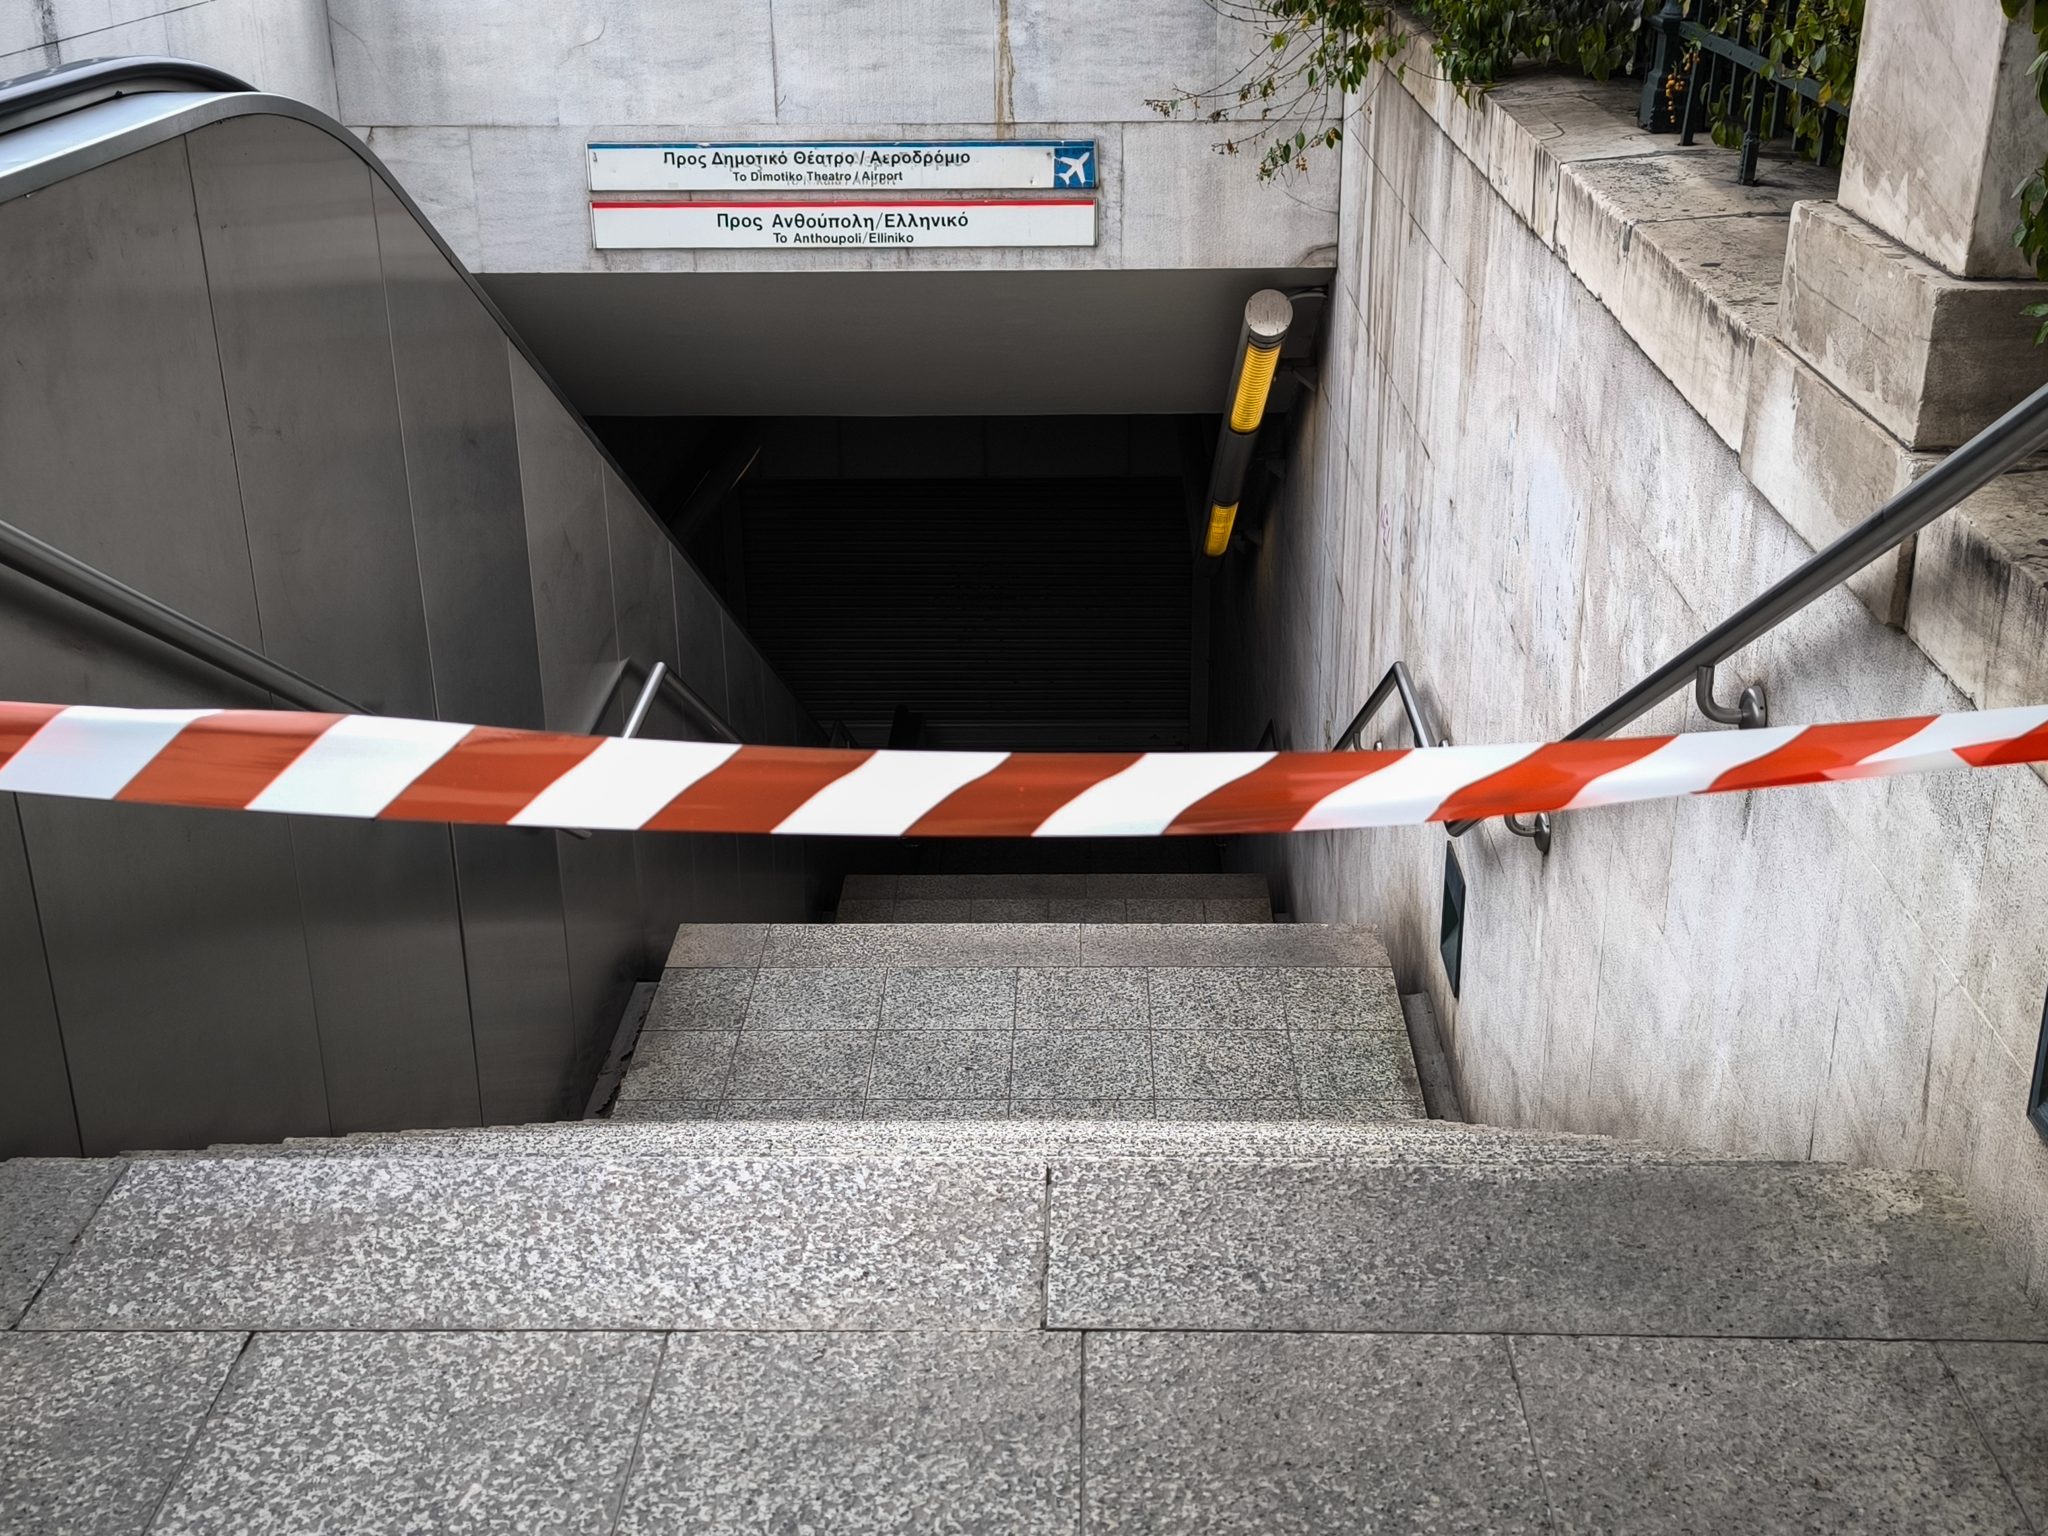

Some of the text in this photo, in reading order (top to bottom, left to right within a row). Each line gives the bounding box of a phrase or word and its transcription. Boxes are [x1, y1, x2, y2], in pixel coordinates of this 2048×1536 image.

[664, 151, 707, 168] Προς
[711, 150, 788, 168] Δημοτικό
[793, 150, 855, 167] Θέατρο
[870, 149, 971, 167] Αεροδρόμιο
[732, 171, 747, 182] To
[750, 171, 803, 182] Dimotiko
[806, 171, 852, 182] Theatro
[862, 171, 903, 183] Airport
[717, 213, 763, 231] Προς
[773, 232, 788, 244] To
